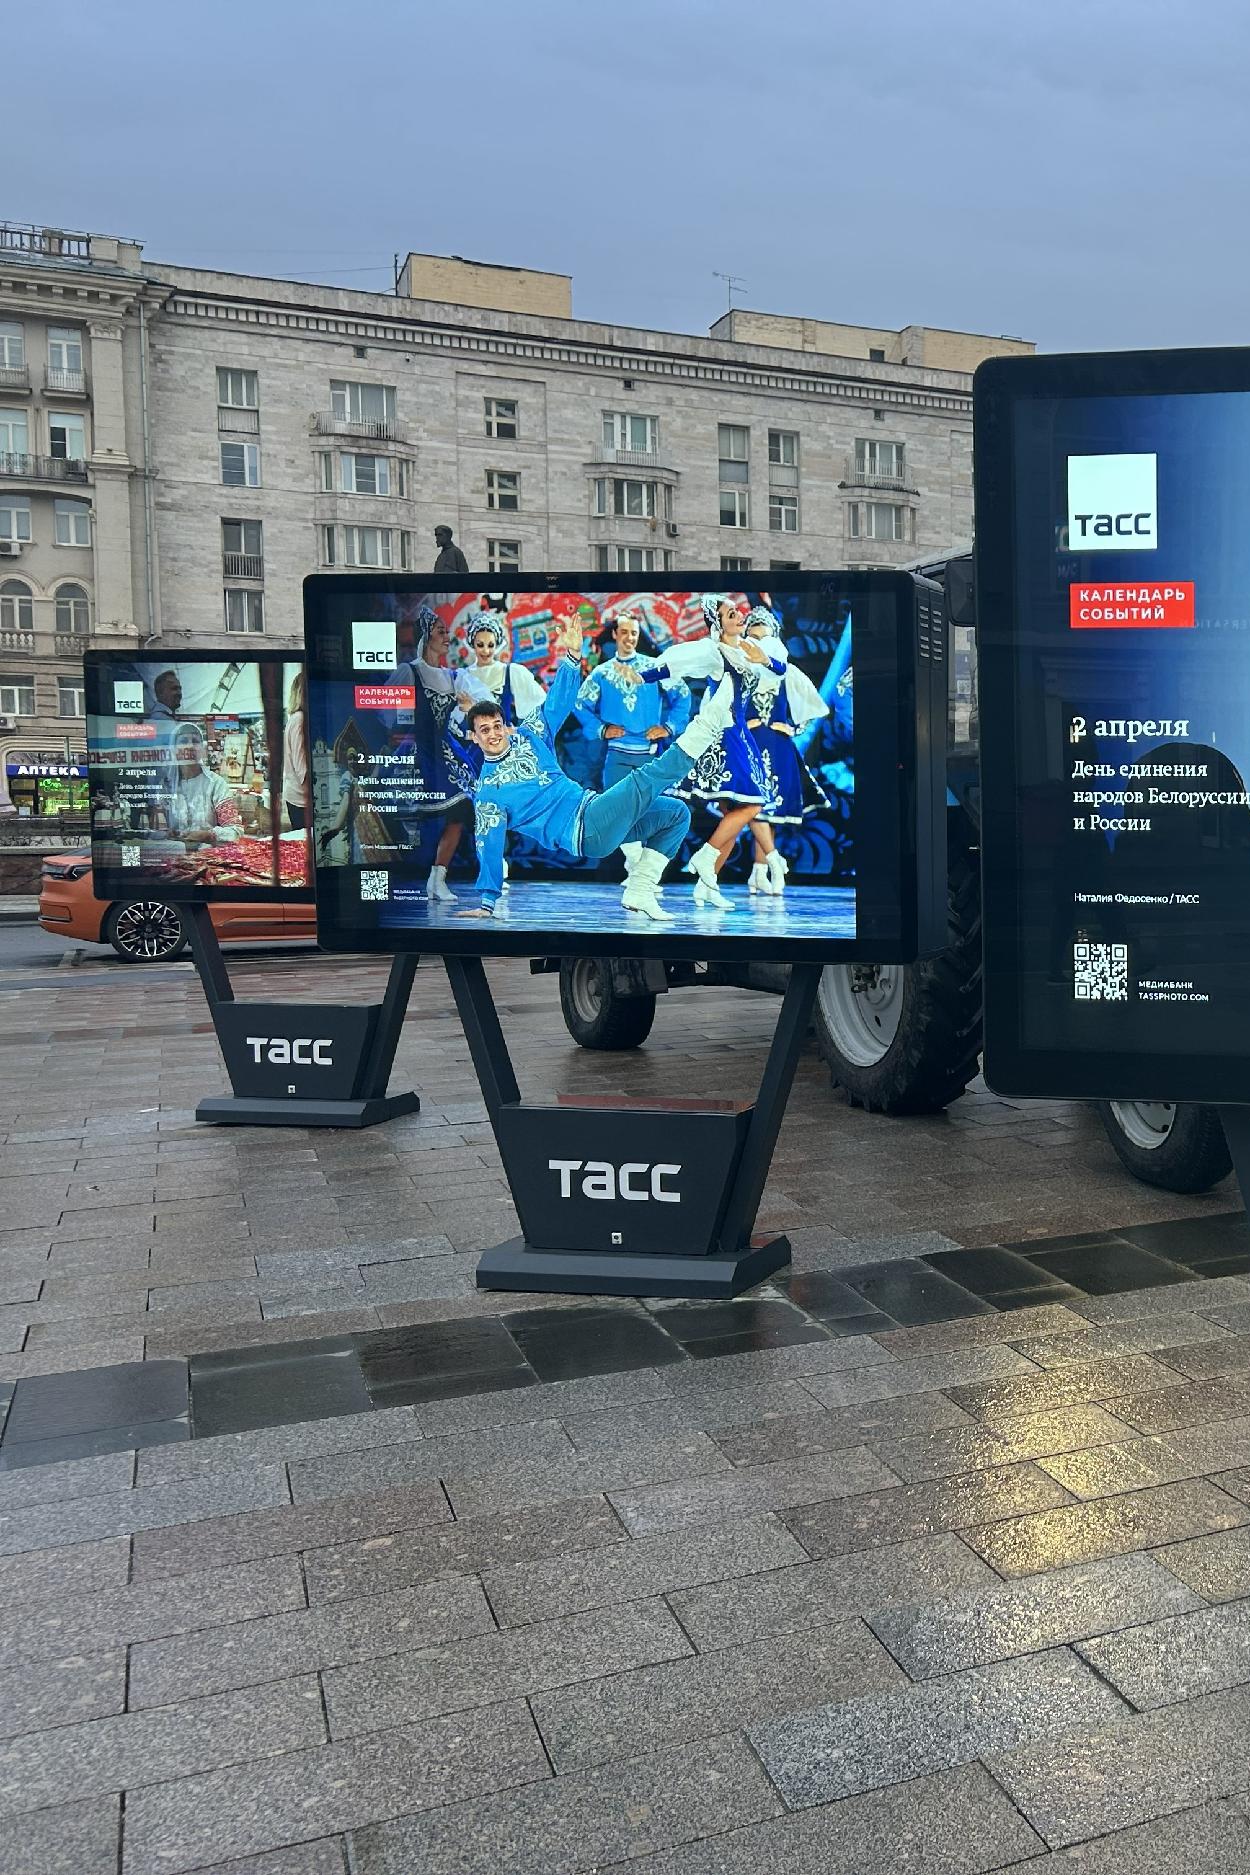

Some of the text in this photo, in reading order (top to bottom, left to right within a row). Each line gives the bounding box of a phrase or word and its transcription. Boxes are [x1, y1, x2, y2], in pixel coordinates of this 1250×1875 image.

[1080, 588, 1185, 603] КАЛЕНДАРЬ
[1080, 605, 1165, 620] СОБЫТИЙ
[360, 688, 411, 697] КАЛЕНДАРЬ
[1072, 717, 1189, 742] 2 апреля
[357, 753, 415, 767] 2 апреля
[17, 765, 80, 776] АПТЕКА
[118, 768, 157, 778] 2 апреля
[1071, 761, 1208, 780] День единения
[358, 776, 424, 786] День единения
[359, 789, 446, 800] народов Белоруссии
[1074, 787, 1250, 807] народов Белоруссии
[367, 804, 398, 813] России
[1074, 815, 1151, 831] и России
[1074, 893, 1113, 902] Наталия
[1175, 894, 1200, 904] ТАСС
[1138, 981, 1193, 989] МЕДИАБАНК
[1138, 992, 1209, 1001] TASSPHOTO.COM
